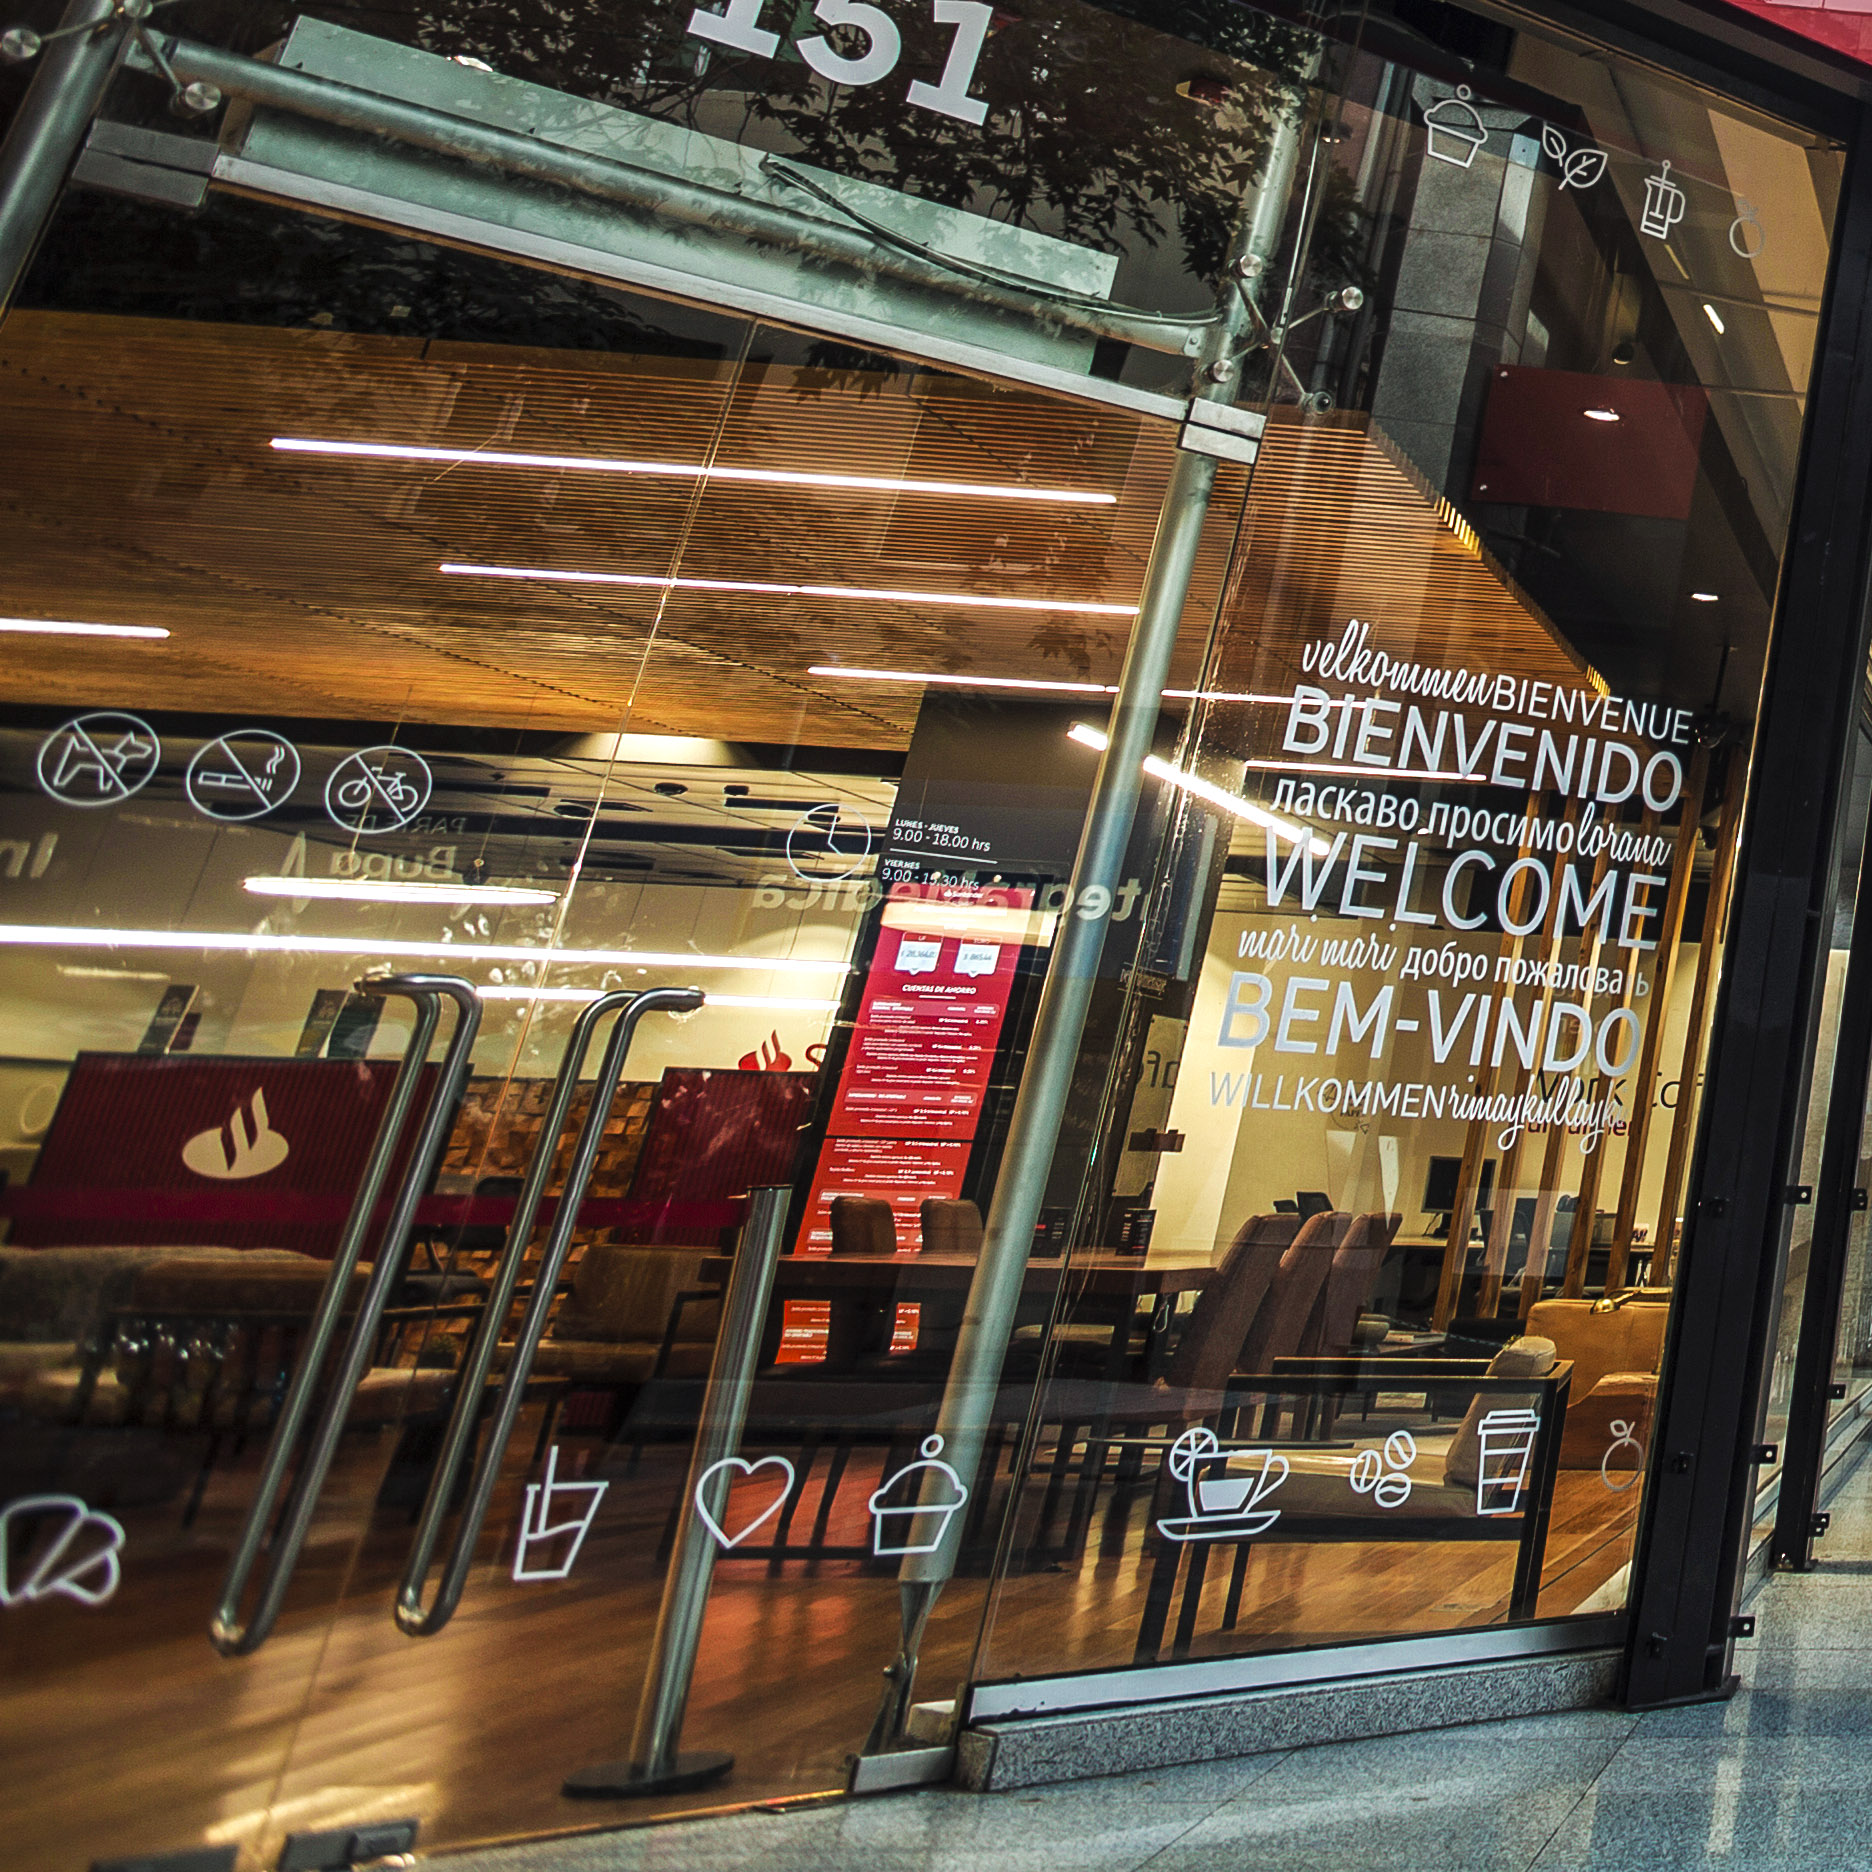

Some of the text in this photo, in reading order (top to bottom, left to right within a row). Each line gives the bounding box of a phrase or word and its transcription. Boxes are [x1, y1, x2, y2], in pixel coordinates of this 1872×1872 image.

[1281, 683, 1683, 812] BIENVENIDO
[892, 827, 923, 843] 9.00
[932, 832, 970, 849] 18.00
[971, 837, 991, 853] hrs
[895, 818, 924, 830] LUNES
[928, 822, 960, 835] JUEVES
[1268, 778, 1575, 855] ласкаво просимо
[881, 867, 912, 884] 9.00
[959, 876, 980, 891] hrs
[884, 858, 921, 870] VIERNES
[1264, 824, 1668, 951] WELCOME
[1237, 913, 1398, 972] mari mari
[1400, 940, 1489, 988] добро
[1217, 970, 1641, 1077] BEM-VINDO
[1209, 1070, 1448, 1119] WILLKOMMEN
